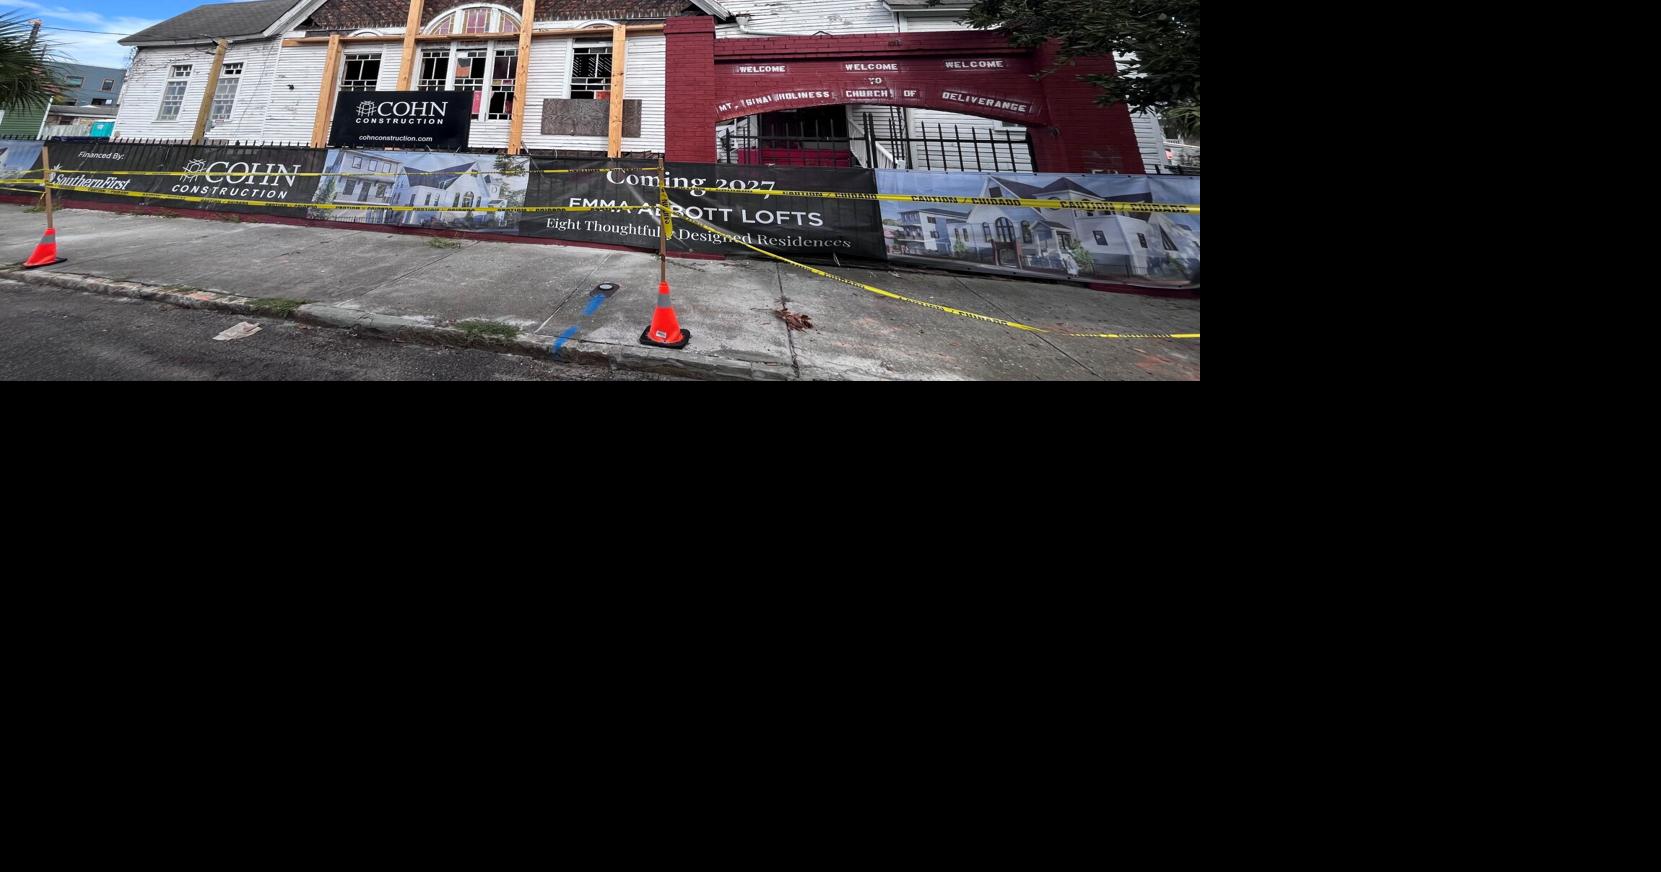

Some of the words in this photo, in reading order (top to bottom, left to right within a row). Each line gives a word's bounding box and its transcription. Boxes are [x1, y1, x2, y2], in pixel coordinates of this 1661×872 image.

[739, 65, 786, 73] WELCOME
[845, 63, 898, 71] WELCOME
[945, 60, 1004, 69] WELCOME
[745, 94, 772, 106] SINAI
[777, 91, 830, 102] HOLINESS
[845, 89, 888, 98] CHURCH
[903, 89, 917, 97] OF
[377, 101, 448, 117] COHN
[355, 117, 444, 125] CONSTRUCTION
[358, 134, 433, 142] cohnconstruction.com
[78, 151, 112, 159] Financed
[112, 152, 125, 160] By:
[204, 161, 302, 187] COHN
[606, 167, 707, 197] Coming
[715, 178, 776, 200] 2027
[171, 184, 288, 199] CONSTRUCTION
[911, 195, 959, 204] CAUTION
[971, 198, 1022, 206] CUIDADO
[1060, 200, 1115, 210] CAUTION
[1130, 203, 1190, 213] CUIDADO
[742, 210, 824, 226] LOFTS
[546, 218, 581, 231] Eight
[584, 220, 676, 240] Thoughtful
[679, 229, 752, 246] Designed
[757, 234, 852, 248] Residences
